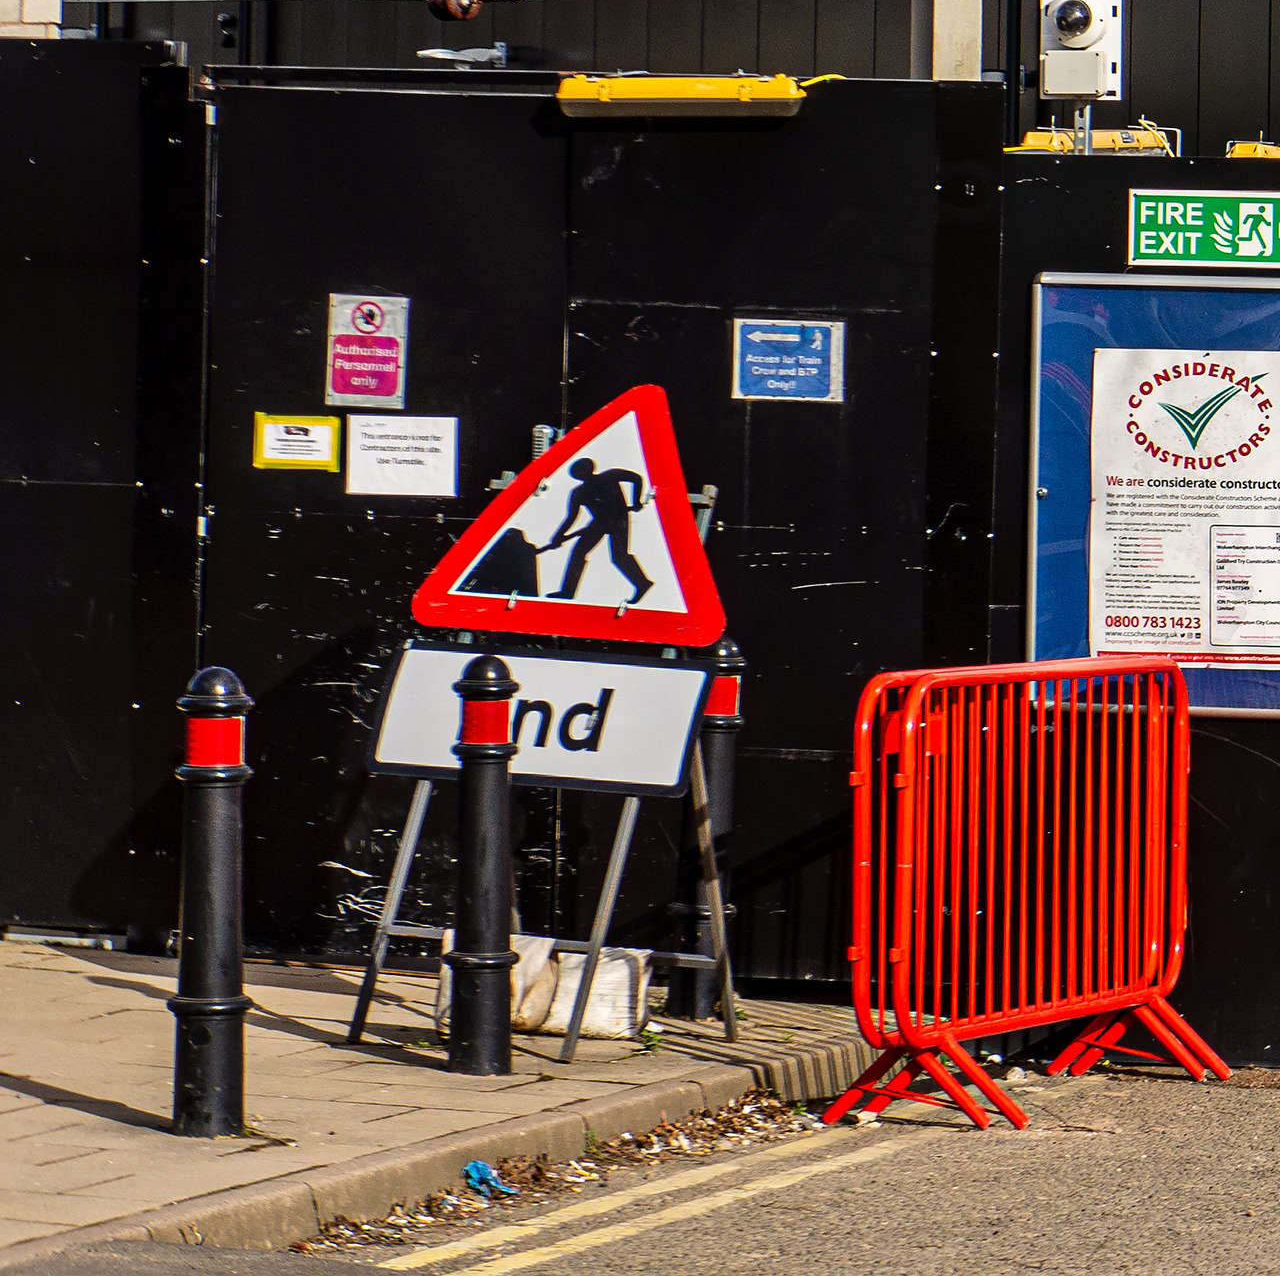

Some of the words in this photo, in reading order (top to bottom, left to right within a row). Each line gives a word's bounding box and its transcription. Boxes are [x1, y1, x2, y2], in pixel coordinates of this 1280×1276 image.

[1140, 202, 1204, 225] FIRE
[1140, 232, 1202, 254] EXIT
[1128, 362, 1273, 413] CONSIDERATE
[1126, 421, 1271, 470] CONSTRUCTORS
[1106, 476, 1124, 486] We
[1126, 478, 1144, 486] are
[1147, 477, 1217, 488] considerate
[1105, 616, 1139, 628] 0800
[1142, 616, 1166, 628] 783
[1171, 617, 1200, 629] 1423
[1105, 631, 1178, 639] www.ccscheme.org.uk
[511, 688, 616, 752] nd
